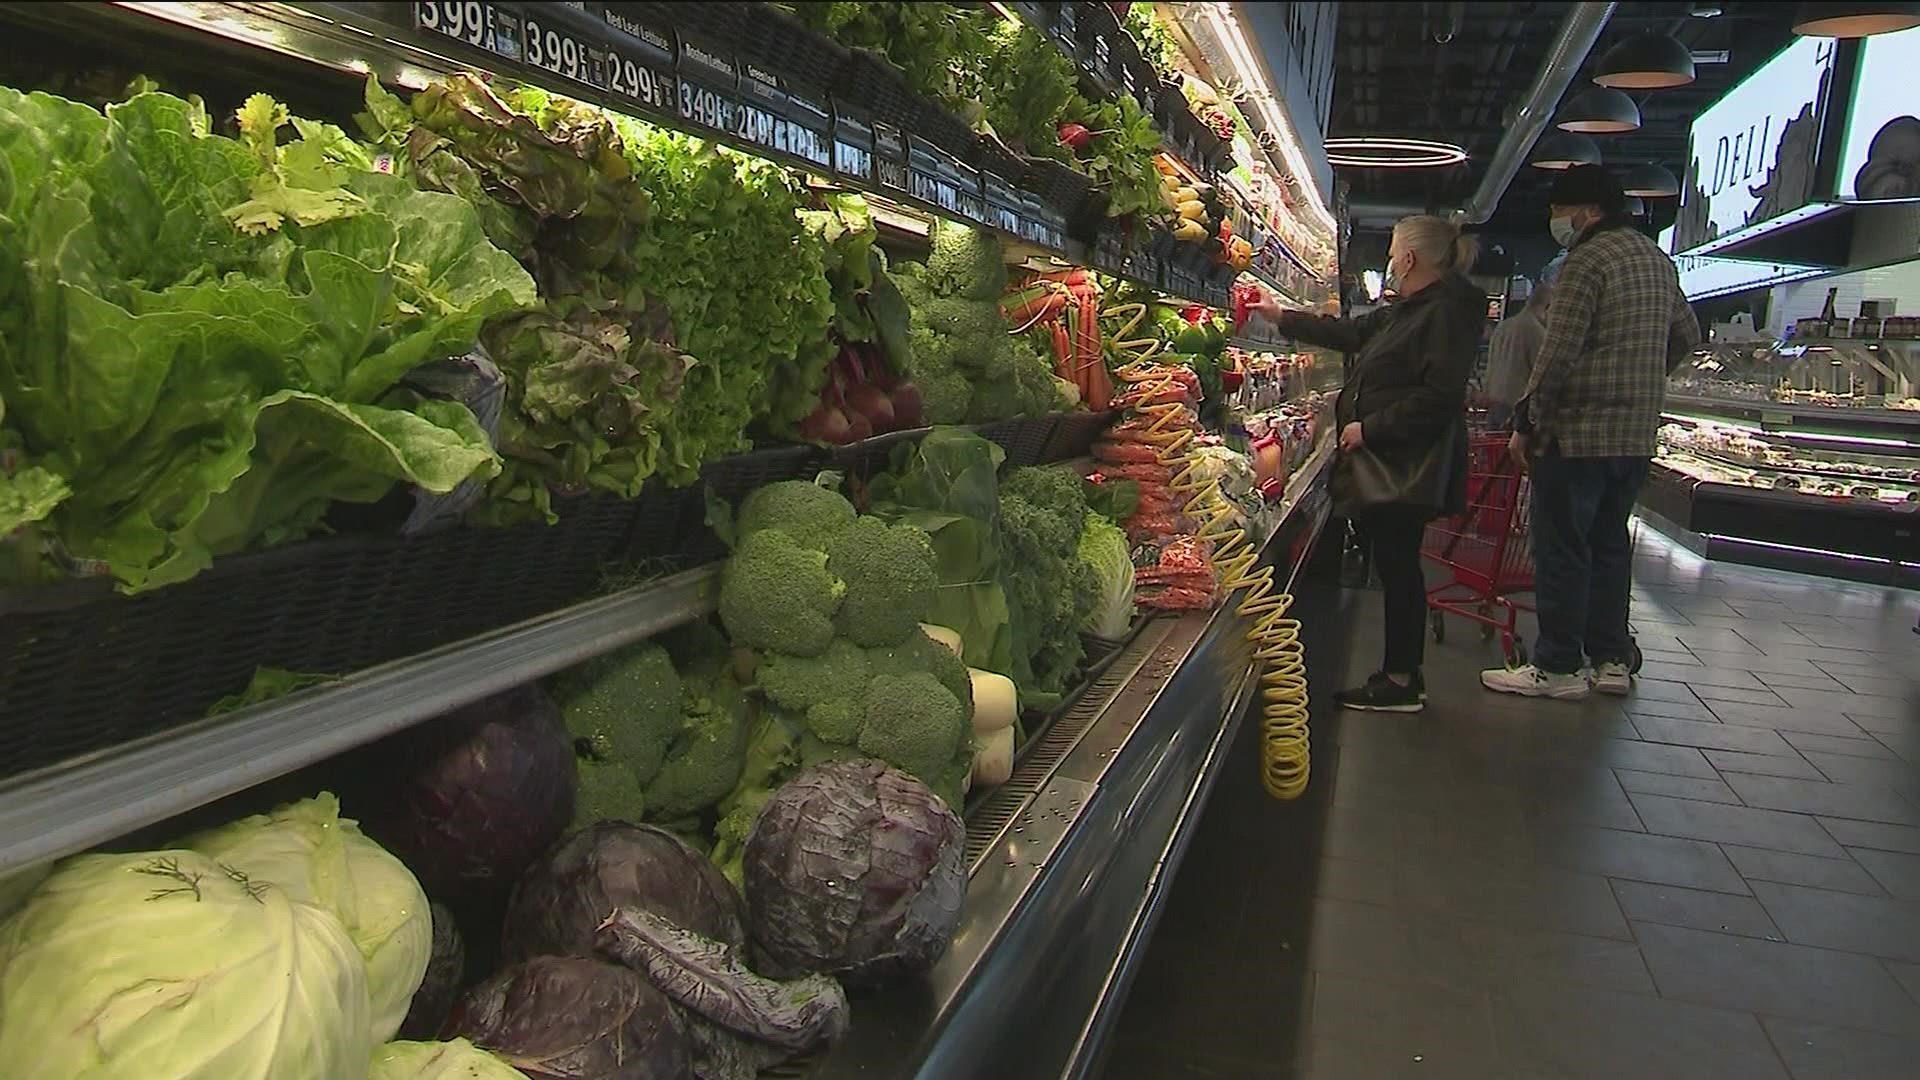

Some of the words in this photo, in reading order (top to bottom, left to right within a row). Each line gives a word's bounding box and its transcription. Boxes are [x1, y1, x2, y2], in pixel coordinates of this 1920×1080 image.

[526, 21, 578, 77] 3.99
[622, 17, 640, 38] Leaf
[640, 25, 669, 51] Lettuce
[608, 52, 652, 104] 2.99
[681, 82, 715, 128] 3.49
[1711, 114, 1771, 196] DELI
